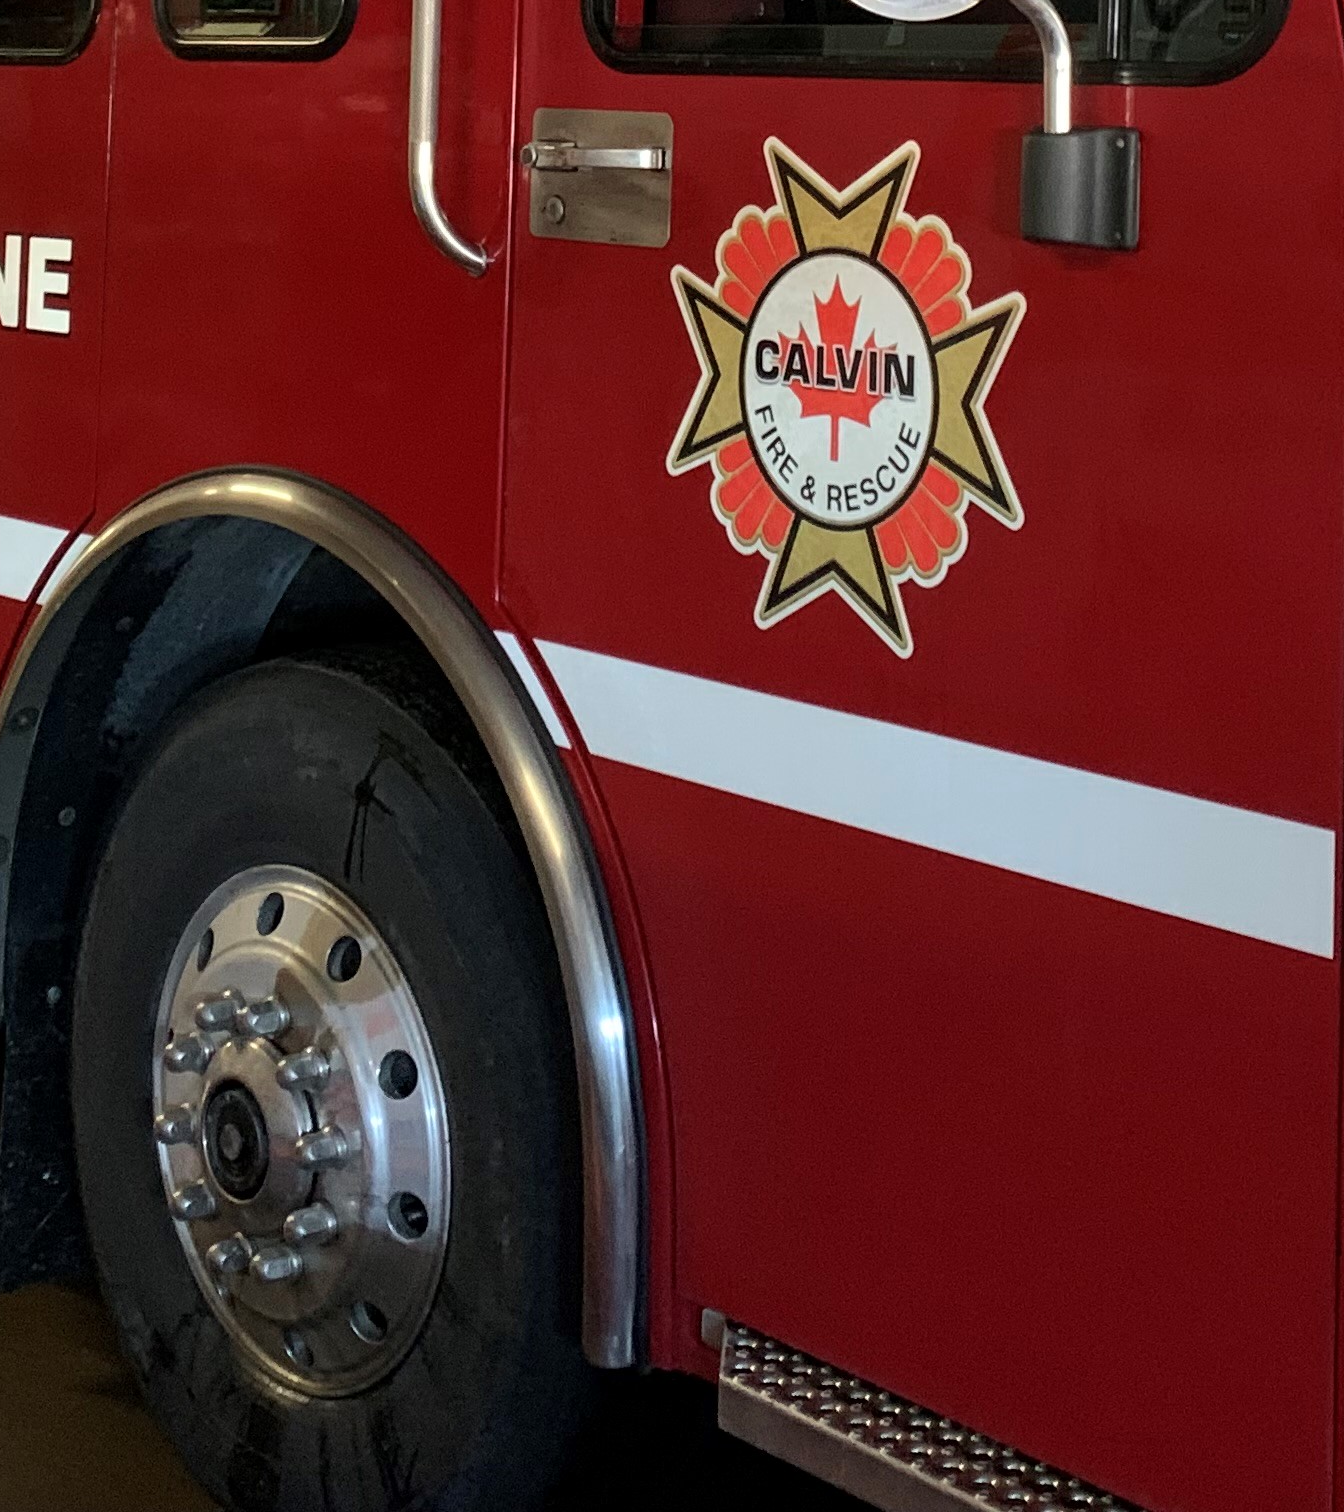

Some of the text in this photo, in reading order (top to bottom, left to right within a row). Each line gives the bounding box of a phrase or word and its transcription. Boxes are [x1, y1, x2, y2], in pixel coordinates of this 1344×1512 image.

[755, 339, 915, 397] CALVIN
[754, 405, 921, 512] FIRE & RESCUE
